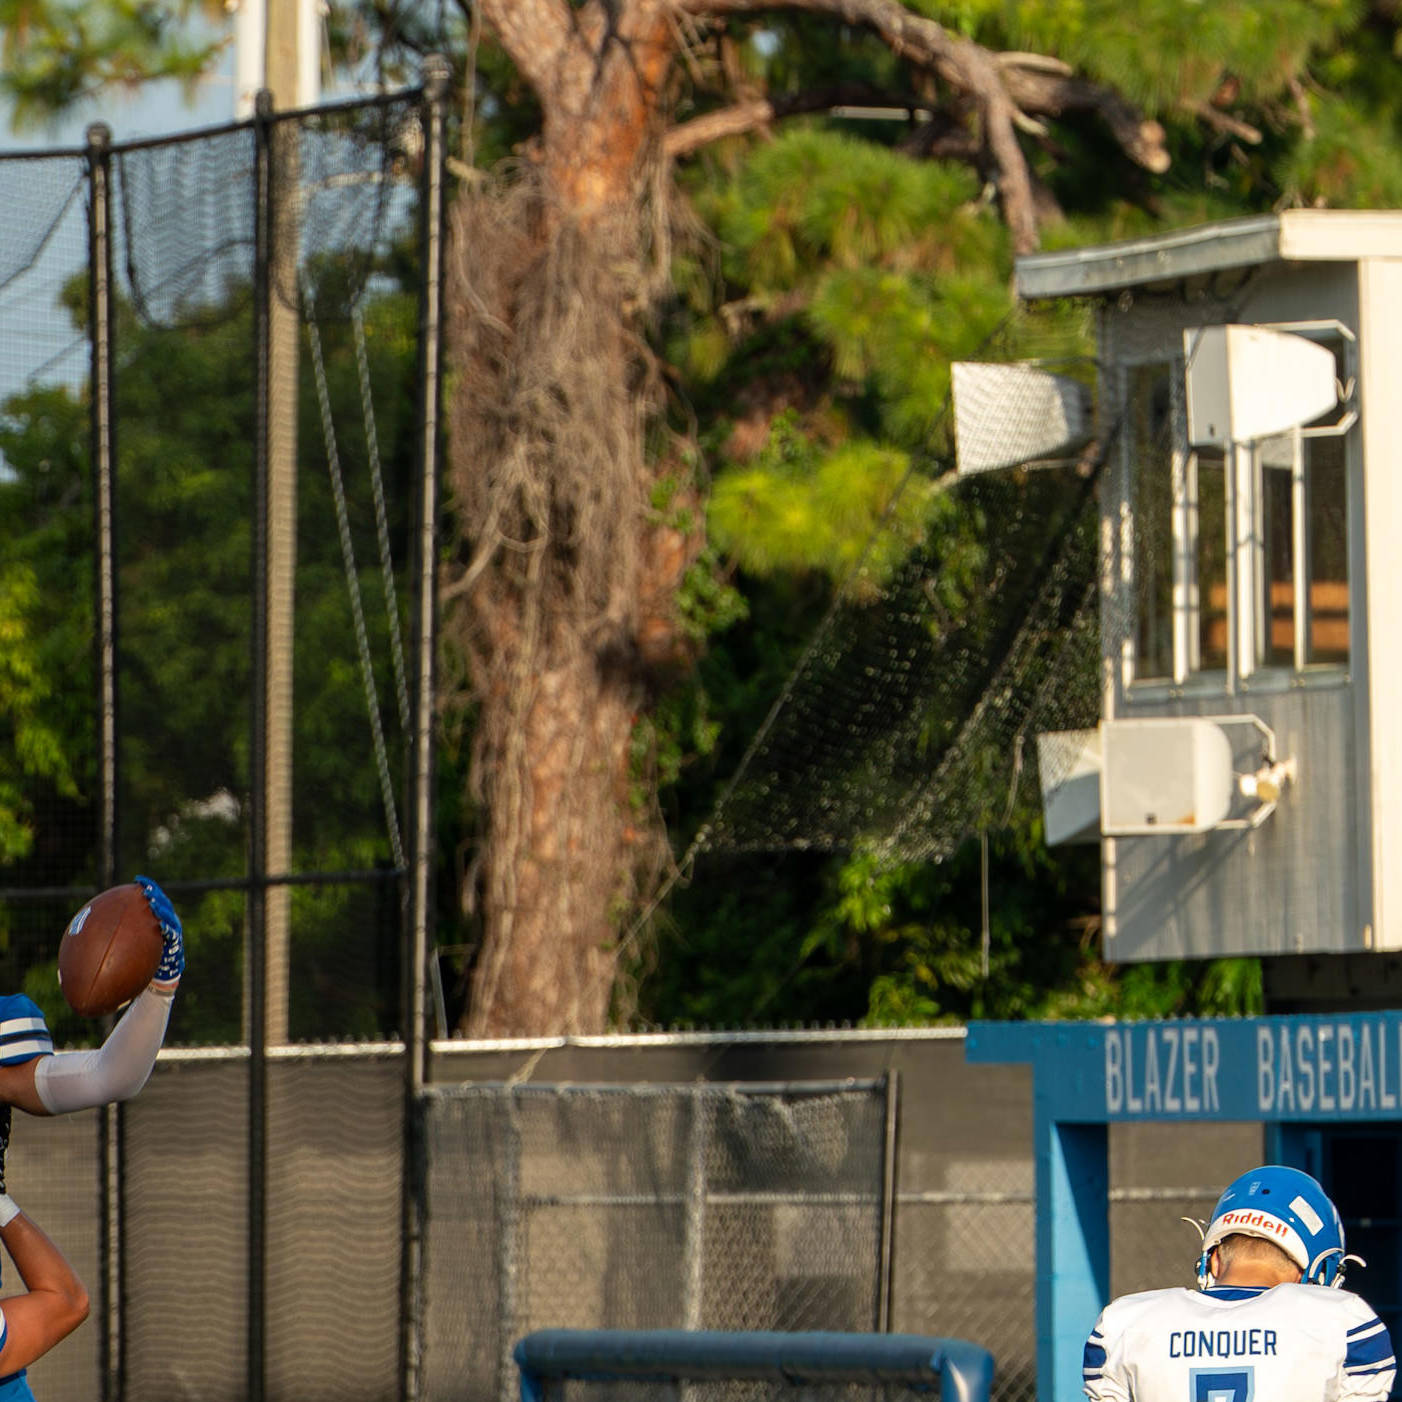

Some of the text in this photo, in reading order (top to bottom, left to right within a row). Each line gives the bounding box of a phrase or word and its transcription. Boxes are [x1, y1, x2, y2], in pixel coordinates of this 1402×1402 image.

[1105, 1021, 1402, 1114] BLAZER BASEBAL
[1222, 1212, 1288, 1237] Riddell
[1170, 1329, 1277, 1359] CONQUER
